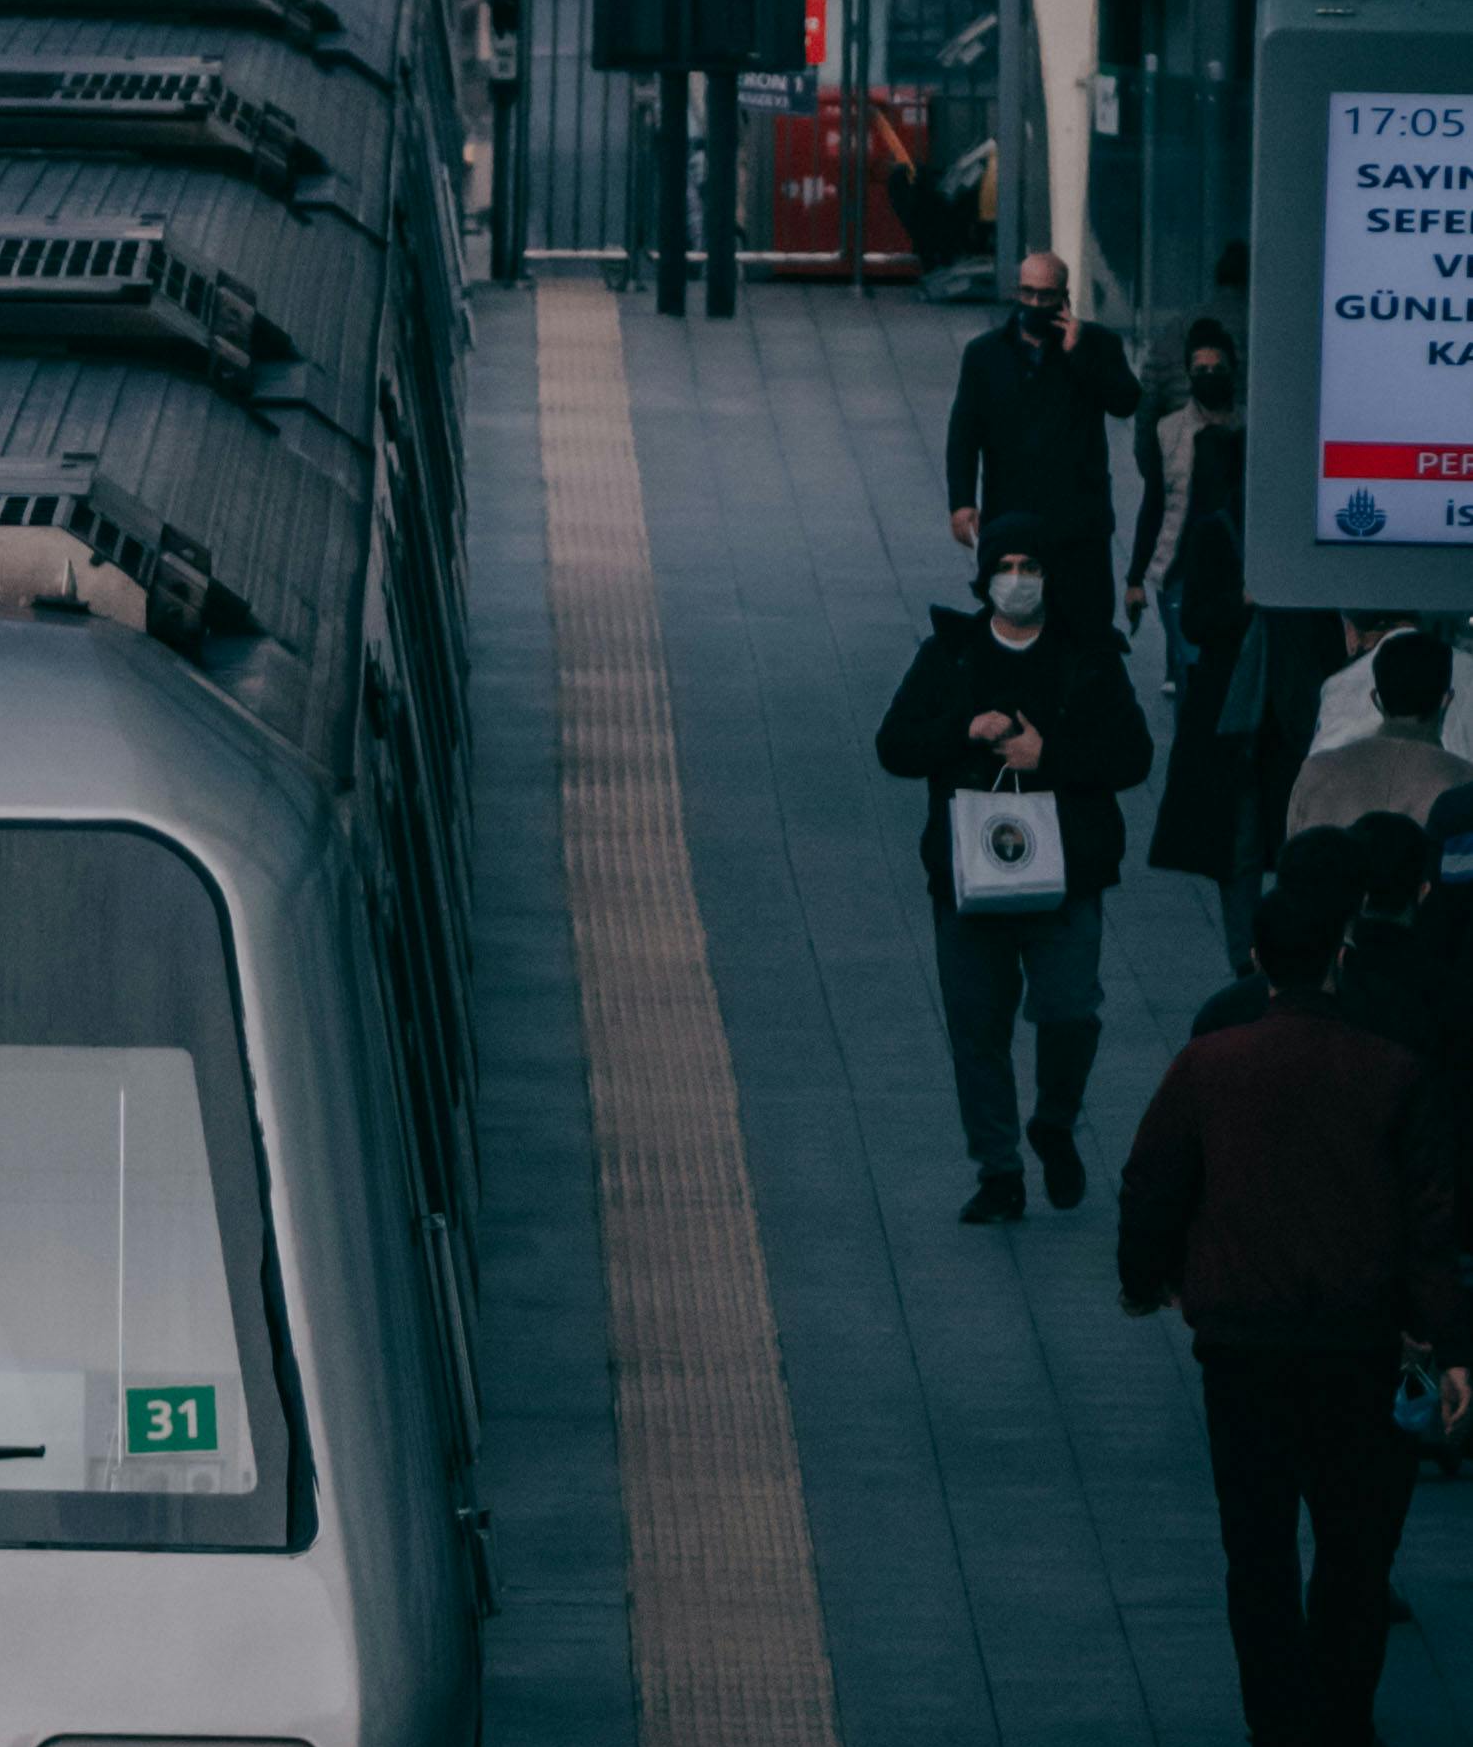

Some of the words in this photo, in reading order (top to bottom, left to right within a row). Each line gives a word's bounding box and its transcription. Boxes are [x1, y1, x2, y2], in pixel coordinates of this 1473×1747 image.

[1344, 106, 1465, 138] 17:05
[1366, 207, 1473, 234] SEFE
[145, 1398, 199, 1441] 31
